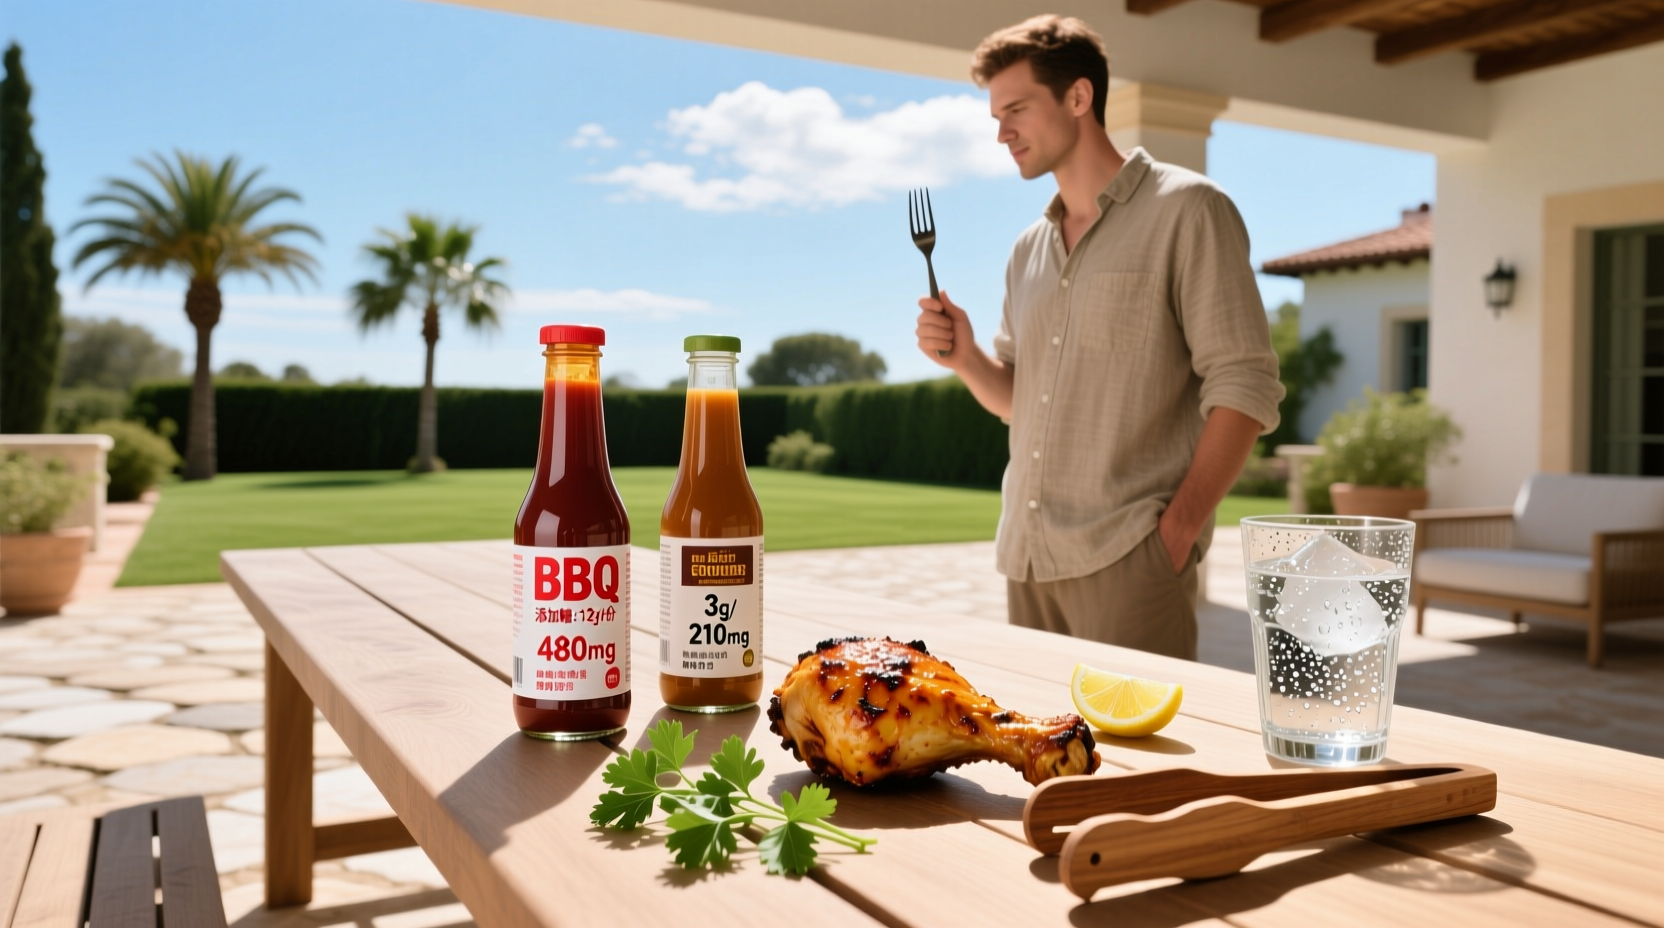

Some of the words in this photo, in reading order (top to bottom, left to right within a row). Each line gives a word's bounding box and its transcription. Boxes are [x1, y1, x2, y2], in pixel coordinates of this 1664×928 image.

[534, 555, 619, 603] BBQ
[704, 594, 737, 622] 3g/
[537, 635, 616, 665] 480mg
[689, 622, 750, 649] 210mg
